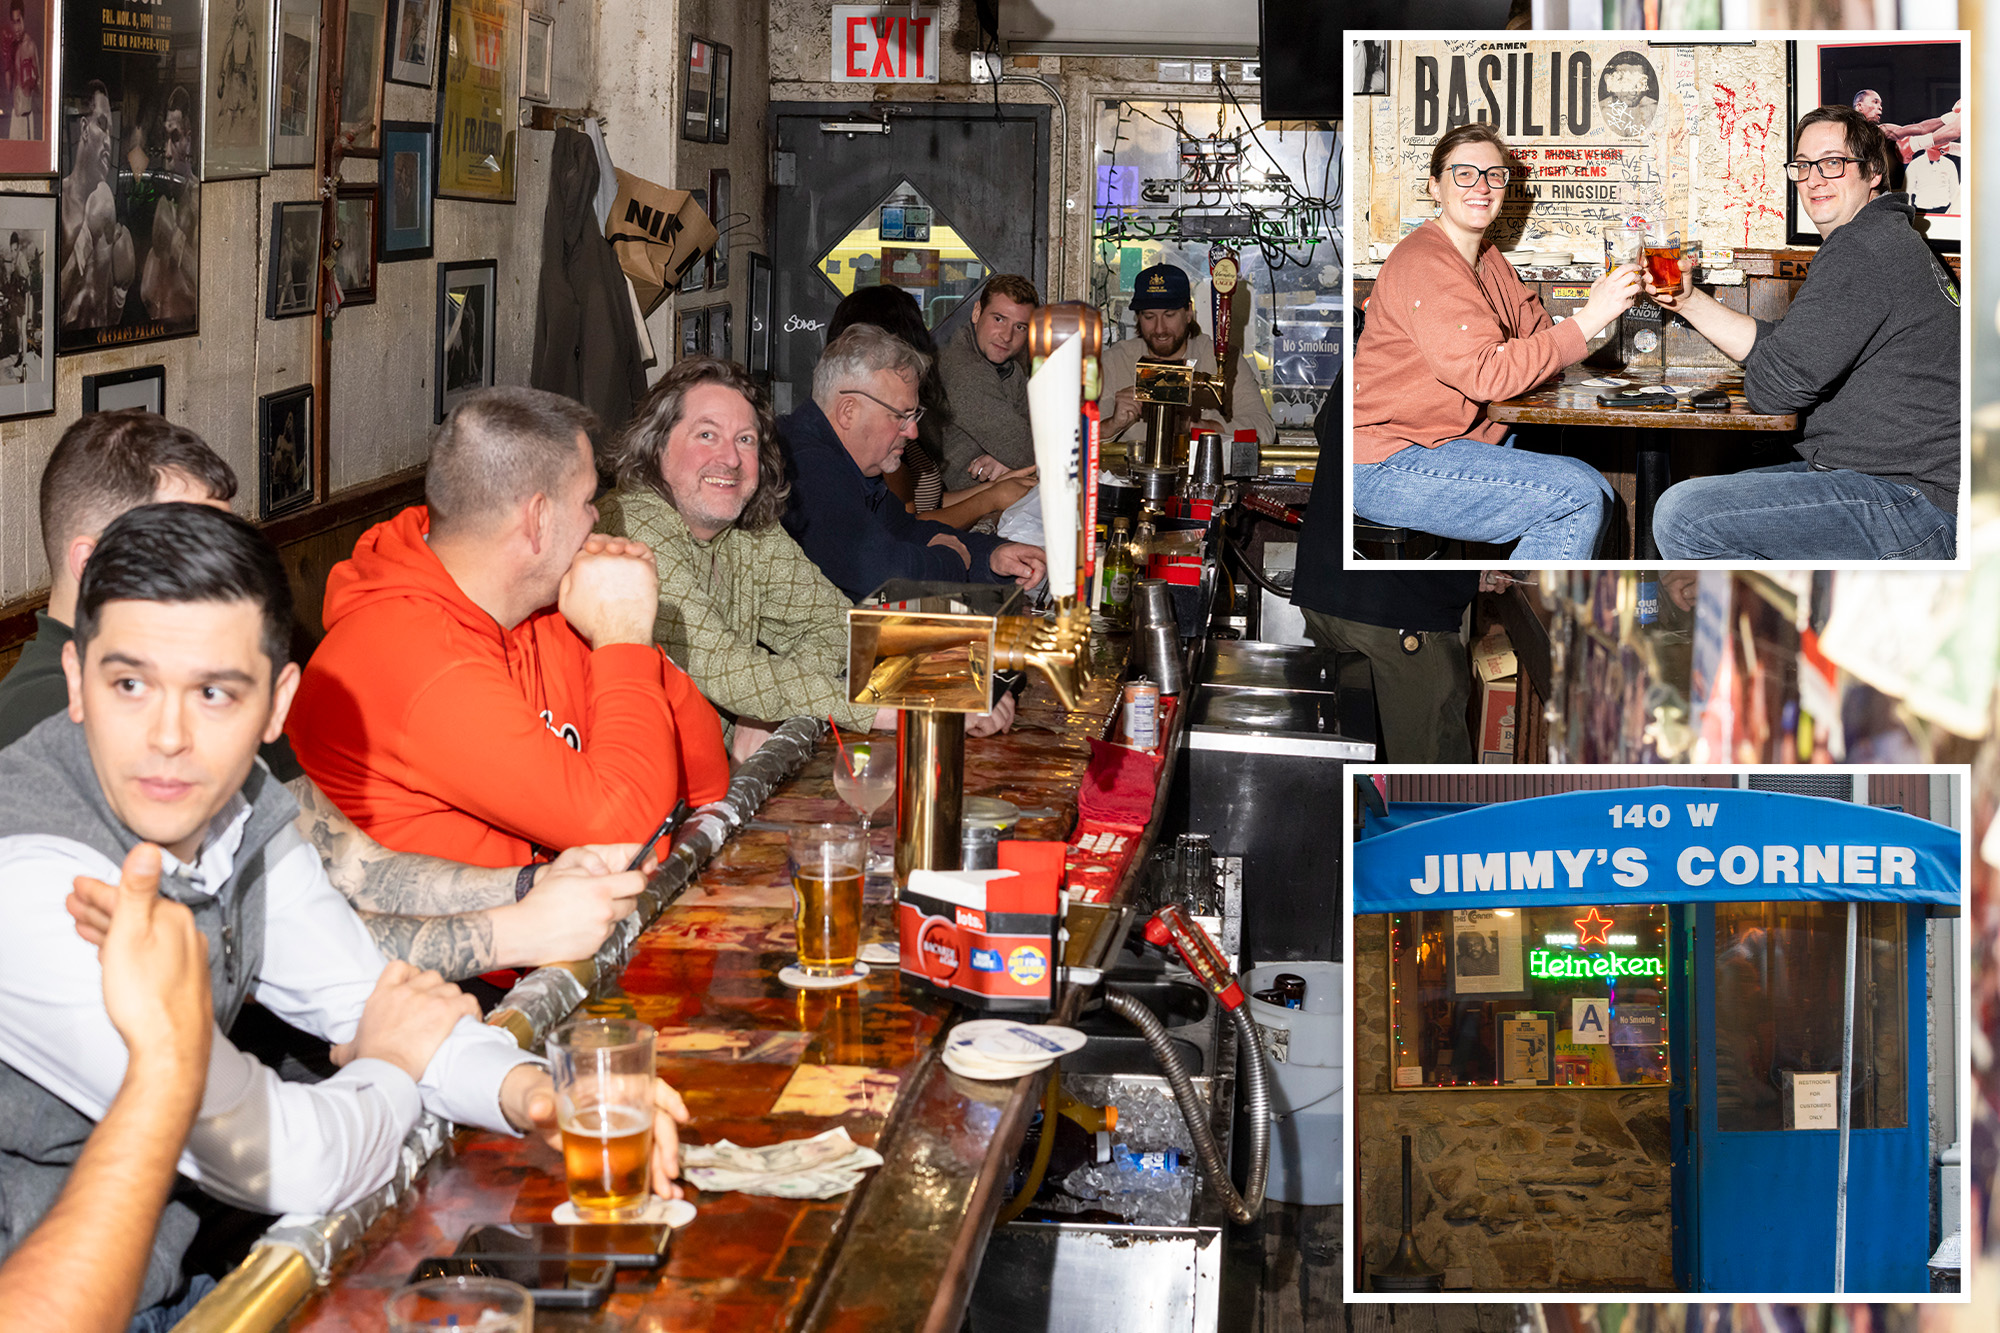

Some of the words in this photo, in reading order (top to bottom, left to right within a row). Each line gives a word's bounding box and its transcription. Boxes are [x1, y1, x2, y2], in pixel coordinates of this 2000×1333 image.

[102, 8, 115, 24] FRI.
[116, 10, 131, 26] NOV.
[140, 13, 153, 29] 1991
[103, 32, 117, 47] LIVE
[119, 34, 128, 47] ON
[129, 35, 170, 52] PAY-PER-VIEW
[846, 16, 931, 78] EXIT
[1481, 42, 1527, 51] CARMEN
[1415, 51, 1592, 136] BASILIO
[463, 117, 502, 157] FRAZIER
[1575, 166, 1607, 177] FILMS
[1507, 185, 1542, 199] THAN
[1629, 308, 1661, 319] KNOW
[1283, 340, 1296, 352] No
[1298, 340, 1340, 355] Smoking
[1090, 420, 1099, 460] BOSTON
[1089, 462, 1098, 494] LAGER
[1086, 495, 1098, 563] REMASTERED
[1608, 803, 1671, 829] 140
[1686, 803, 1719, 827] W
[1410, 847, 1649, 895] JIMMY'S
[1676, 845, 1917, 887] CORNER
[956, 909, 984, 930] lots.
[1468, 910, 1494, 924] CORNER
[1545, 934, 1578, 945] TRADE
[1608, 935, 1637, 946] MARK
[1529, 950, 1664, 977] Heineken
[1578, 1004, 1604, 1032] A
[1620, 1016, 1629, 1024] No
[1629, 1015, 1656, 1025] Smoking
